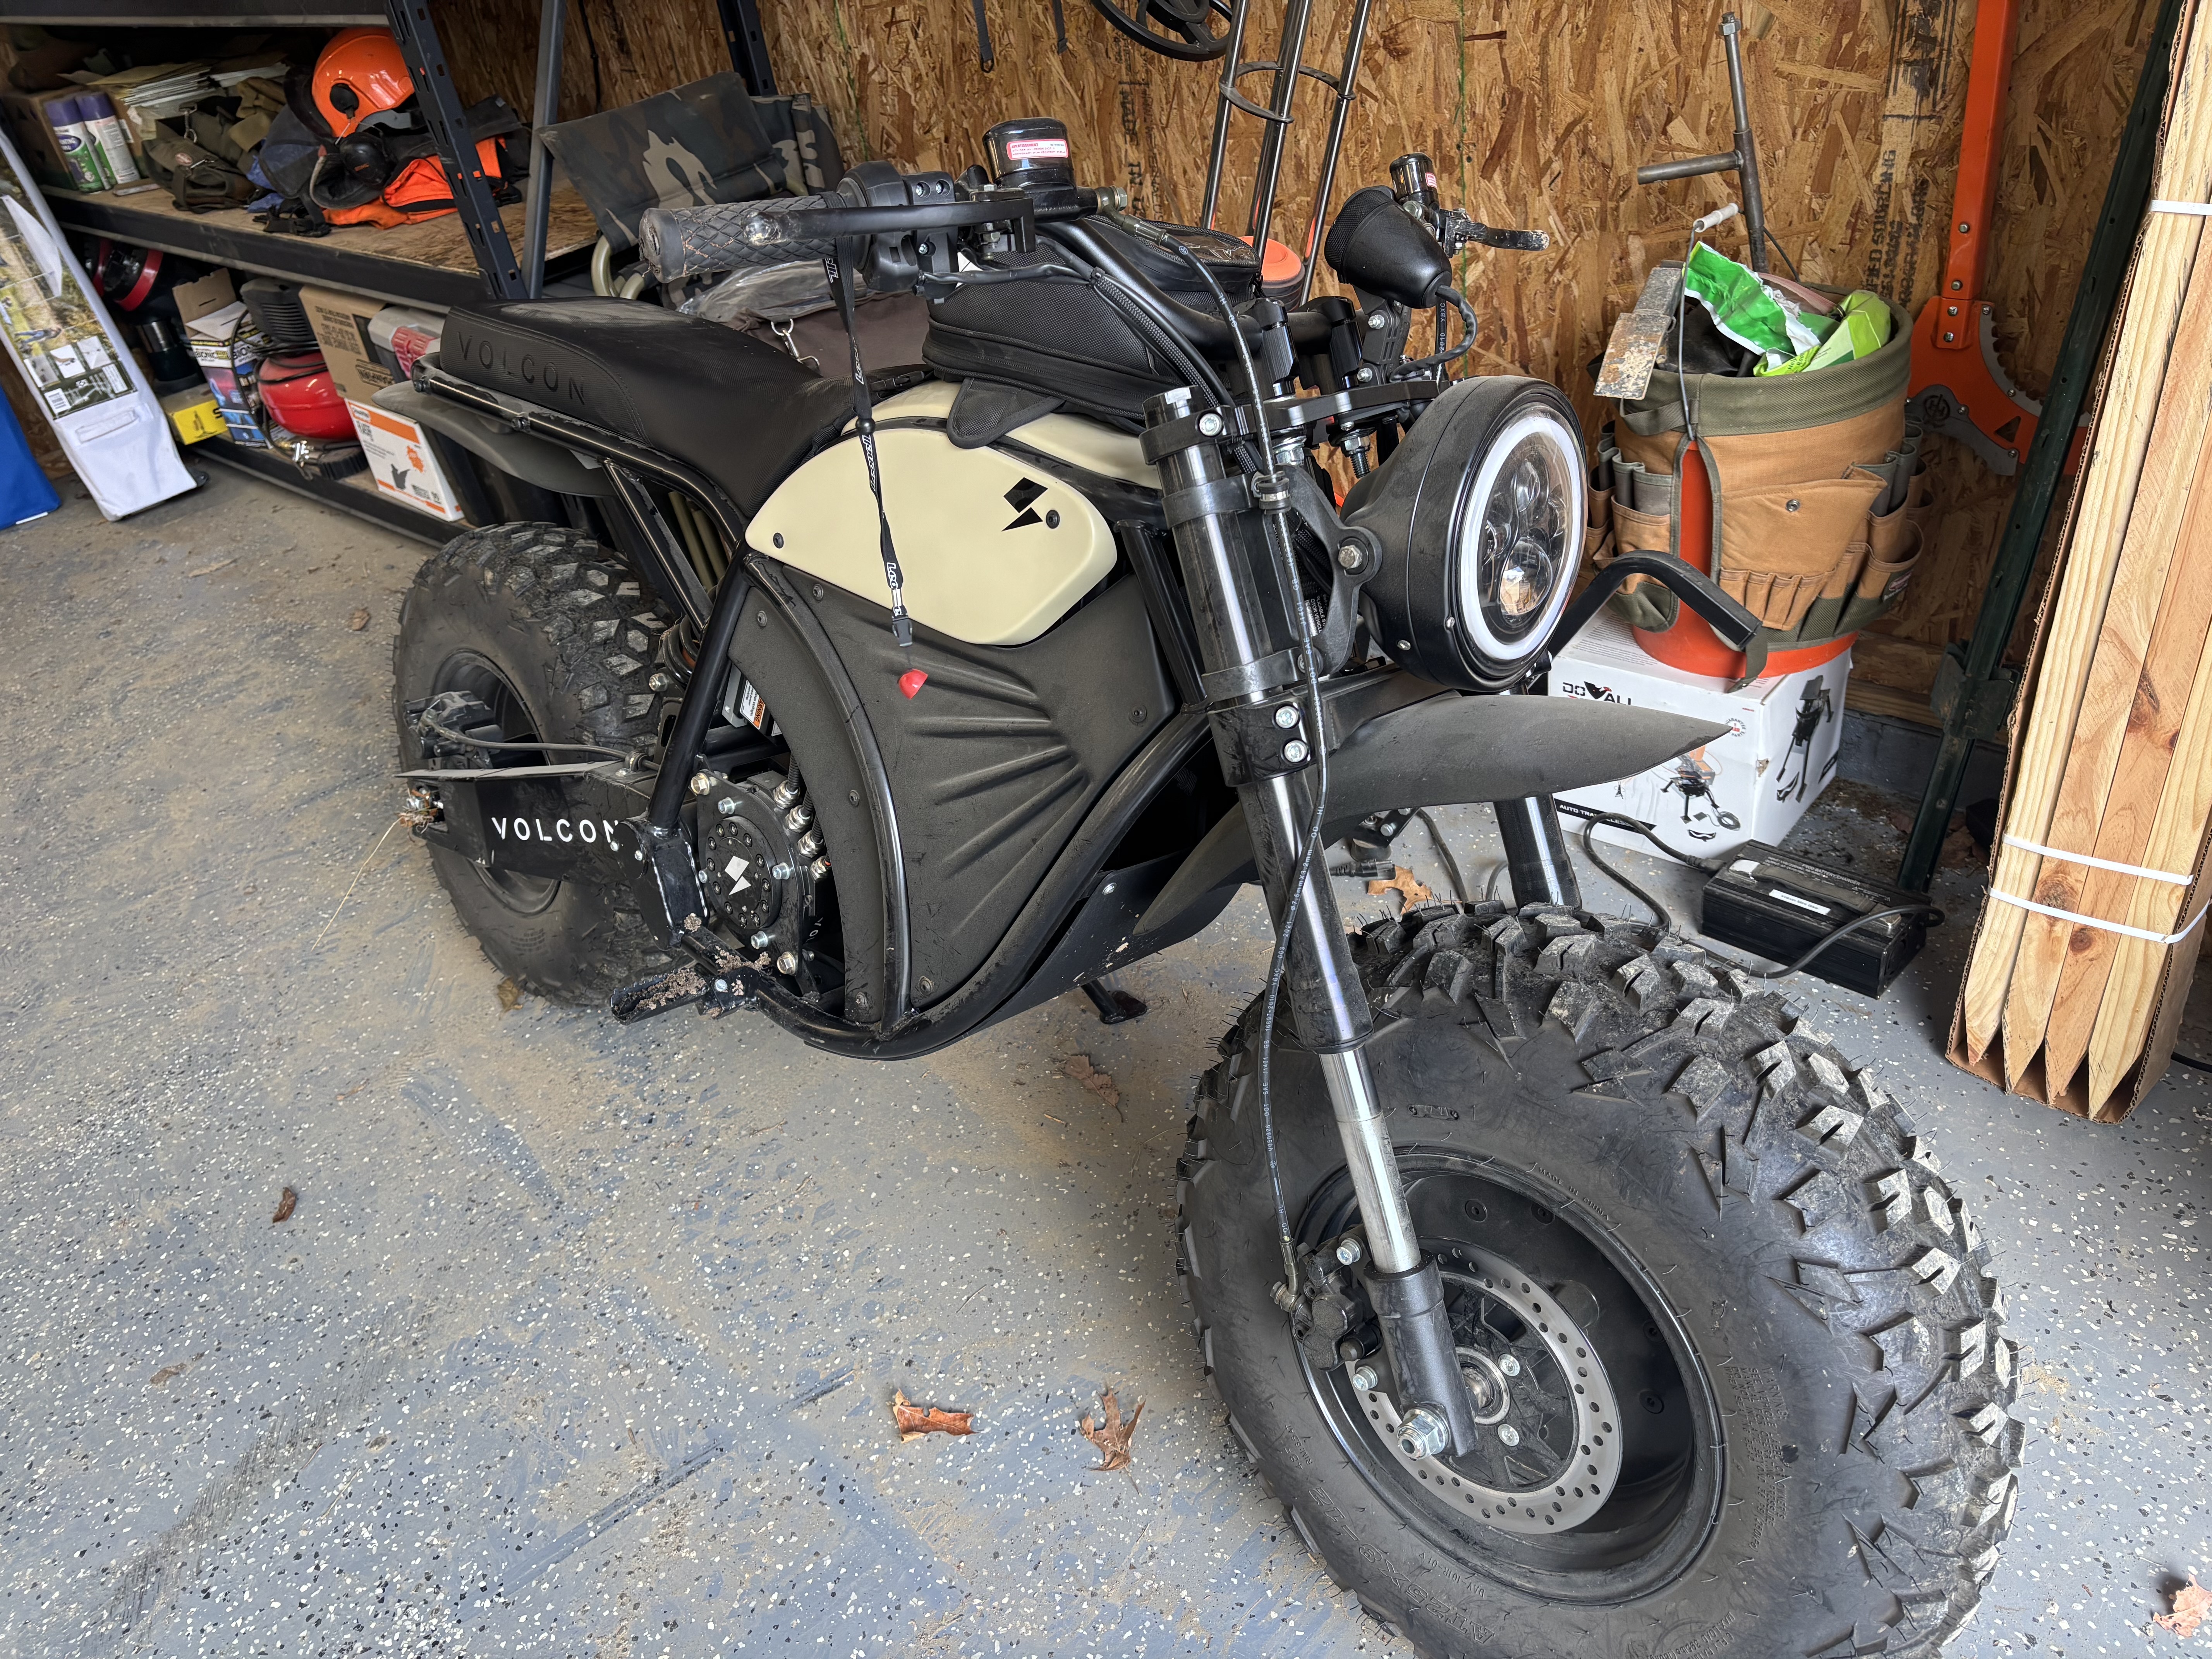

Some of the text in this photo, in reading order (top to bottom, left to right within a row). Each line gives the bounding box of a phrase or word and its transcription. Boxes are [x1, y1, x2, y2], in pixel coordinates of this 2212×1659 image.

[458, 331, 586, 406] VOLCON
[755, 698, 764, 722] ARNING
[1317, 804, 1324, 815] HL
[1559, 804, 1579, 813] AUTO
[491, 817, 618, 843] VOLCON
[1311, 826, 1319, 838] OD
[1283, 921, 1292, 938] 2021
[1271, 968, 1280, 986] YBXC
[1265, 994, 1275, 1032] 16897-2010
[1263, 1040, 1270, 1049] GB
[1539, 1167, 1609, 1221] MADE IN CHINA
